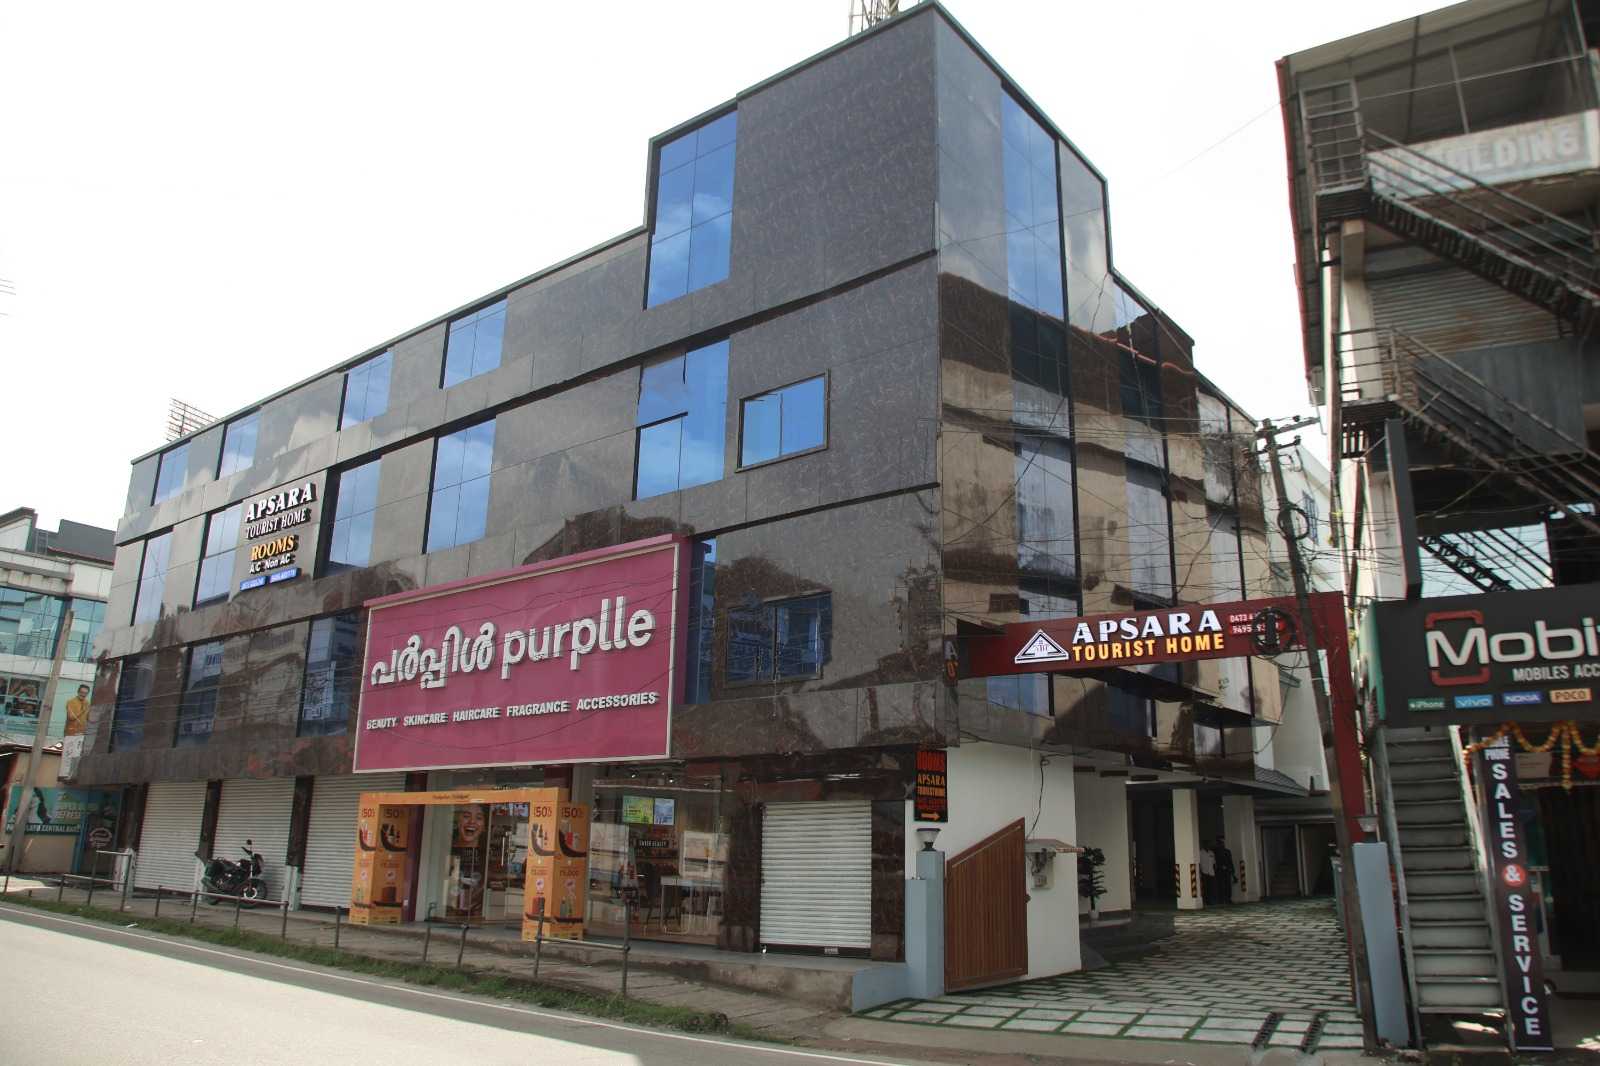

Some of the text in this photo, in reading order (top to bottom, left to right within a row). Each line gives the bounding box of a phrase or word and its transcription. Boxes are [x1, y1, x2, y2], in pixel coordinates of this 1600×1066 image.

[245, 483, 314, 522] APSARA
[246, 507, 308, 539] TOURIST HOME
[250, 535, 296, 561] ROOMS
[264, 558, 278, 570] Non
[502, 596, 655, 679] purplle
[1072, 609, 1223, 645] APSARA
[1073, 633, 1225, 662] TOURIST HOME
[1426, 617, 1600, 668] Mobi
[1513, 665, 1570, 681] MOBILES
[366, 691, 659, 730] BEAUTY SKINCARE HAIRCARE FRAGRANCE ACCESSORIES
[1505, 694, 1540, 703] NOKIA
[1555, 690, 1587, 701] POCO
[917, 773, 945, 787] APSARA
[1491, 763, 1519, 860] SALES
[1505, 865, 1521, 882] &
[1508, 894, 1542, 1036] SERVICE
